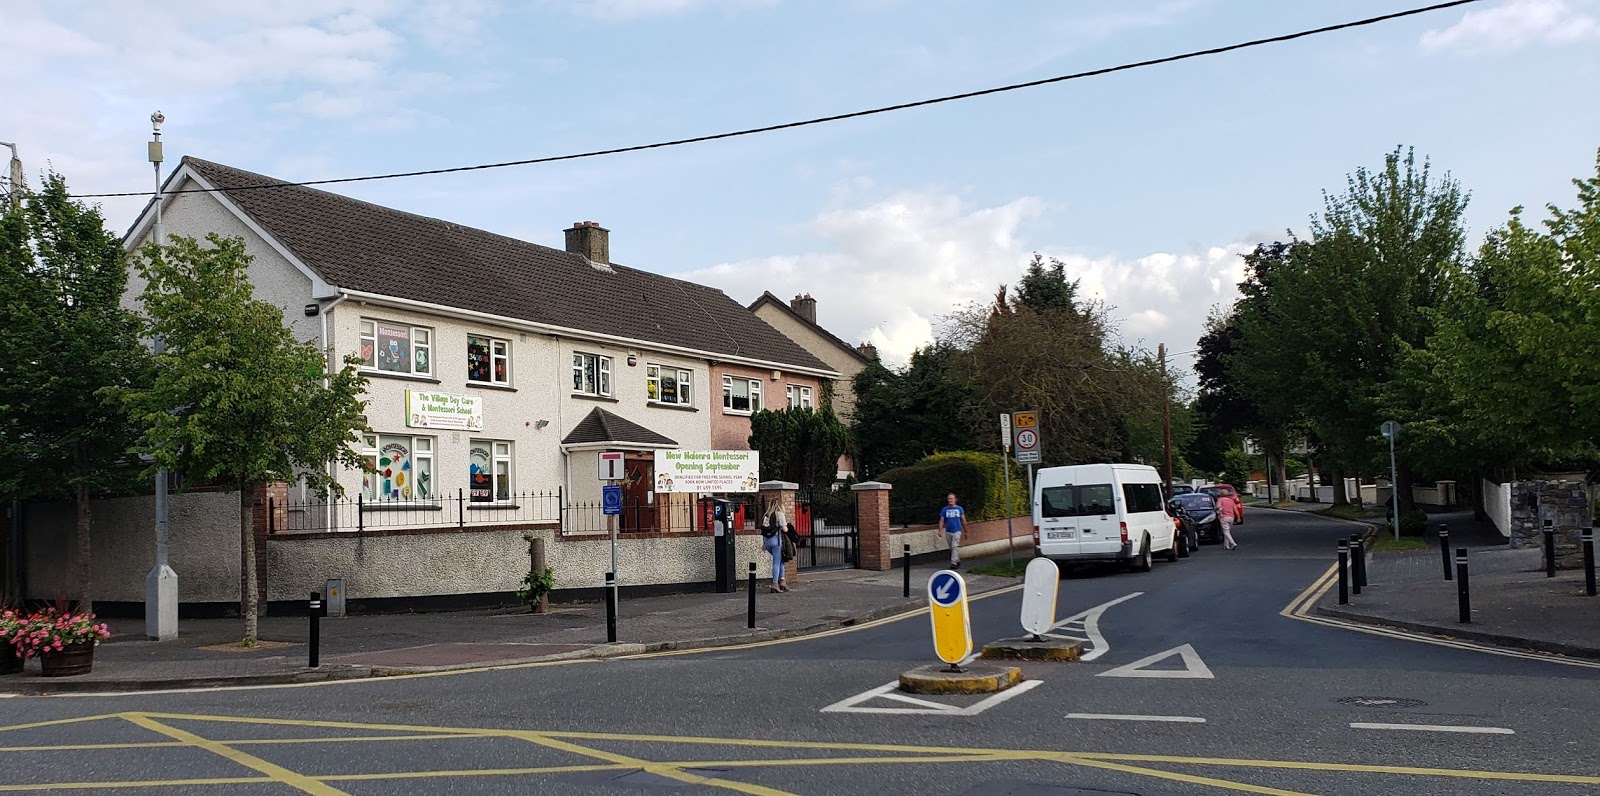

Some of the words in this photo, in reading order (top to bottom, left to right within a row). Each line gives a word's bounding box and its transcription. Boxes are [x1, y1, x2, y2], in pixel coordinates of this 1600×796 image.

[419, 393, 429, 401] The
[431, 394, 449, 405] Village
[449, 396, 459, 407] Day
[461, 397, 474, 405] Care
[428, 404, 455, 413] Montessori
[456, 406, 472, 414] School
[1021, 434, 1033, 443] 30
[666, 452, 681, 460] New
[713, 452, 749, 460] Montessori
[675, 462, 703, 473] Opening
[705, 462, 740, 473] September
[715, 505, 721, 515] P
